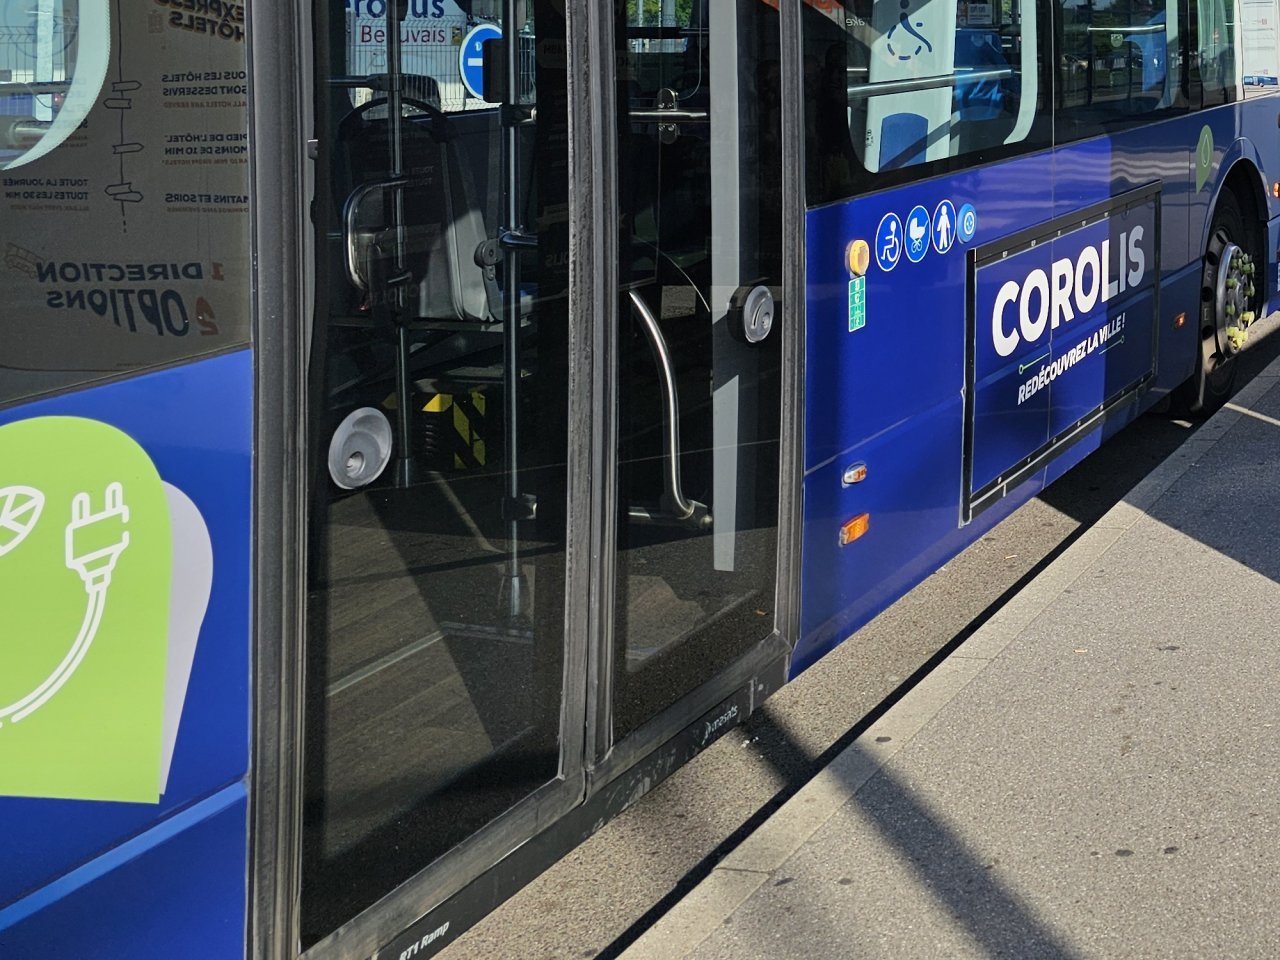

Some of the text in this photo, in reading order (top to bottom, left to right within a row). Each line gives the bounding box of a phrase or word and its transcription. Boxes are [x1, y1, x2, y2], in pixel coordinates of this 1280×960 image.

[361, 24, 445, 43] Beuvais
[992, 225, 1145, 357] COROLIS
[1017, 338, 1088, 406] REDÉCOUVREZ
[1086, 335, 1099, 354] LA
[421, 921, 450, 949] Ramp
